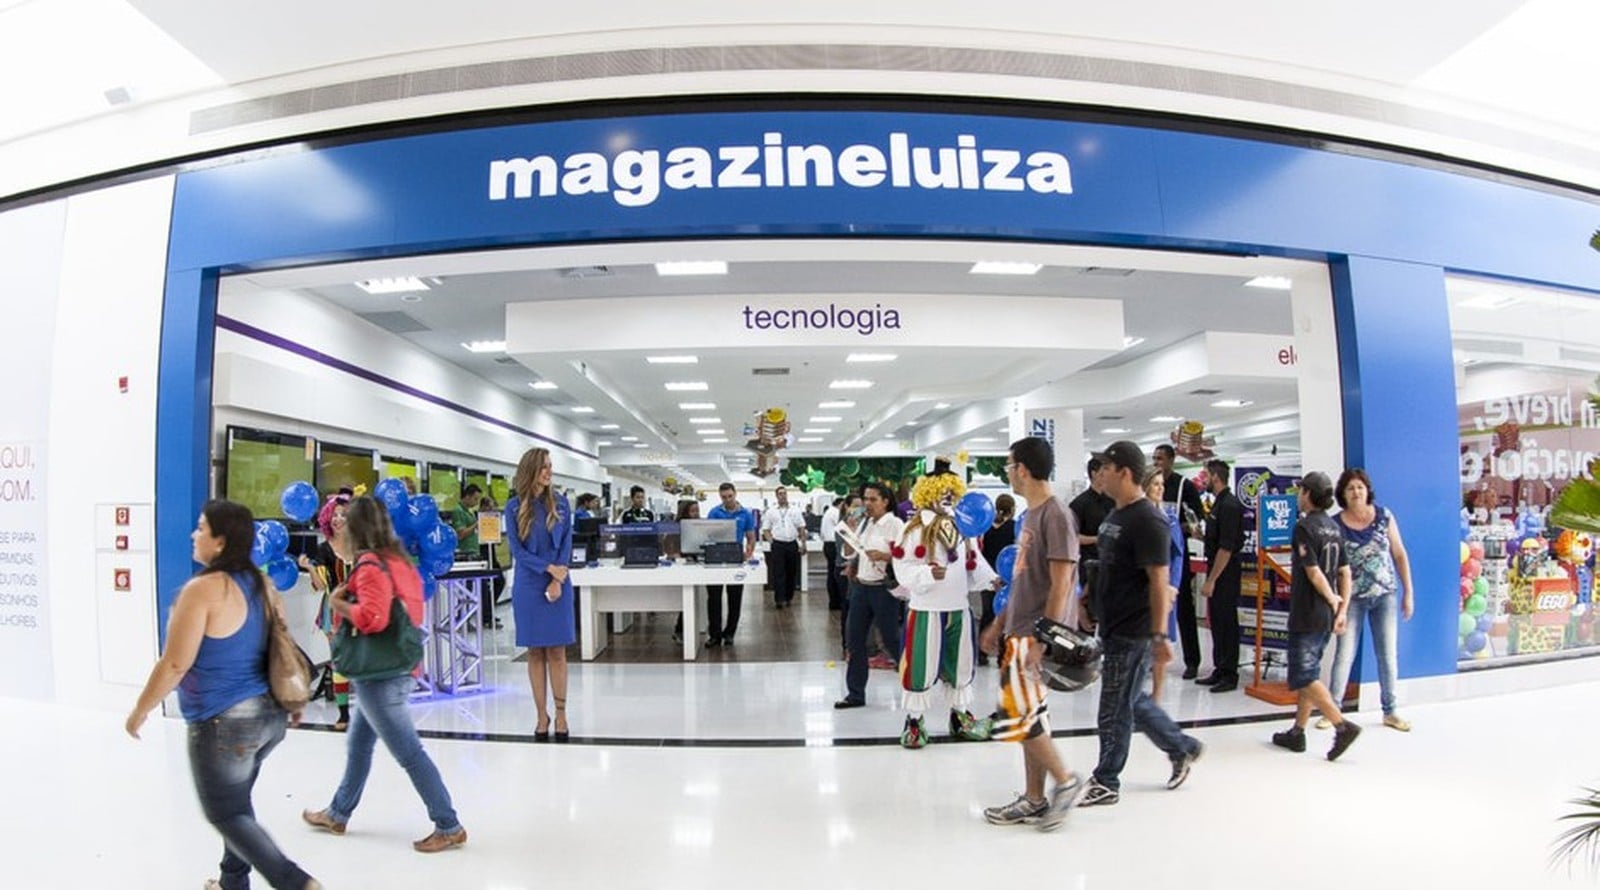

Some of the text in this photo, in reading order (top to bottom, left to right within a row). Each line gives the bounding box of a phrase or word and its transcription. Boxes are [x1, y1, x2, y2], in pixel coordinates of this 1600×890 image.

[488, 132, 1073, 207] magazineluiza
[742, 303, 901, 334] tecnologia
[1278, 345, 1298, 366] el
[1028, 419, 1047, 437] iz
[0, 446, 35, 470] QUI,
[0, 479, 35, 502] OM.
[1536, 593, 1568, 610] LEGO
